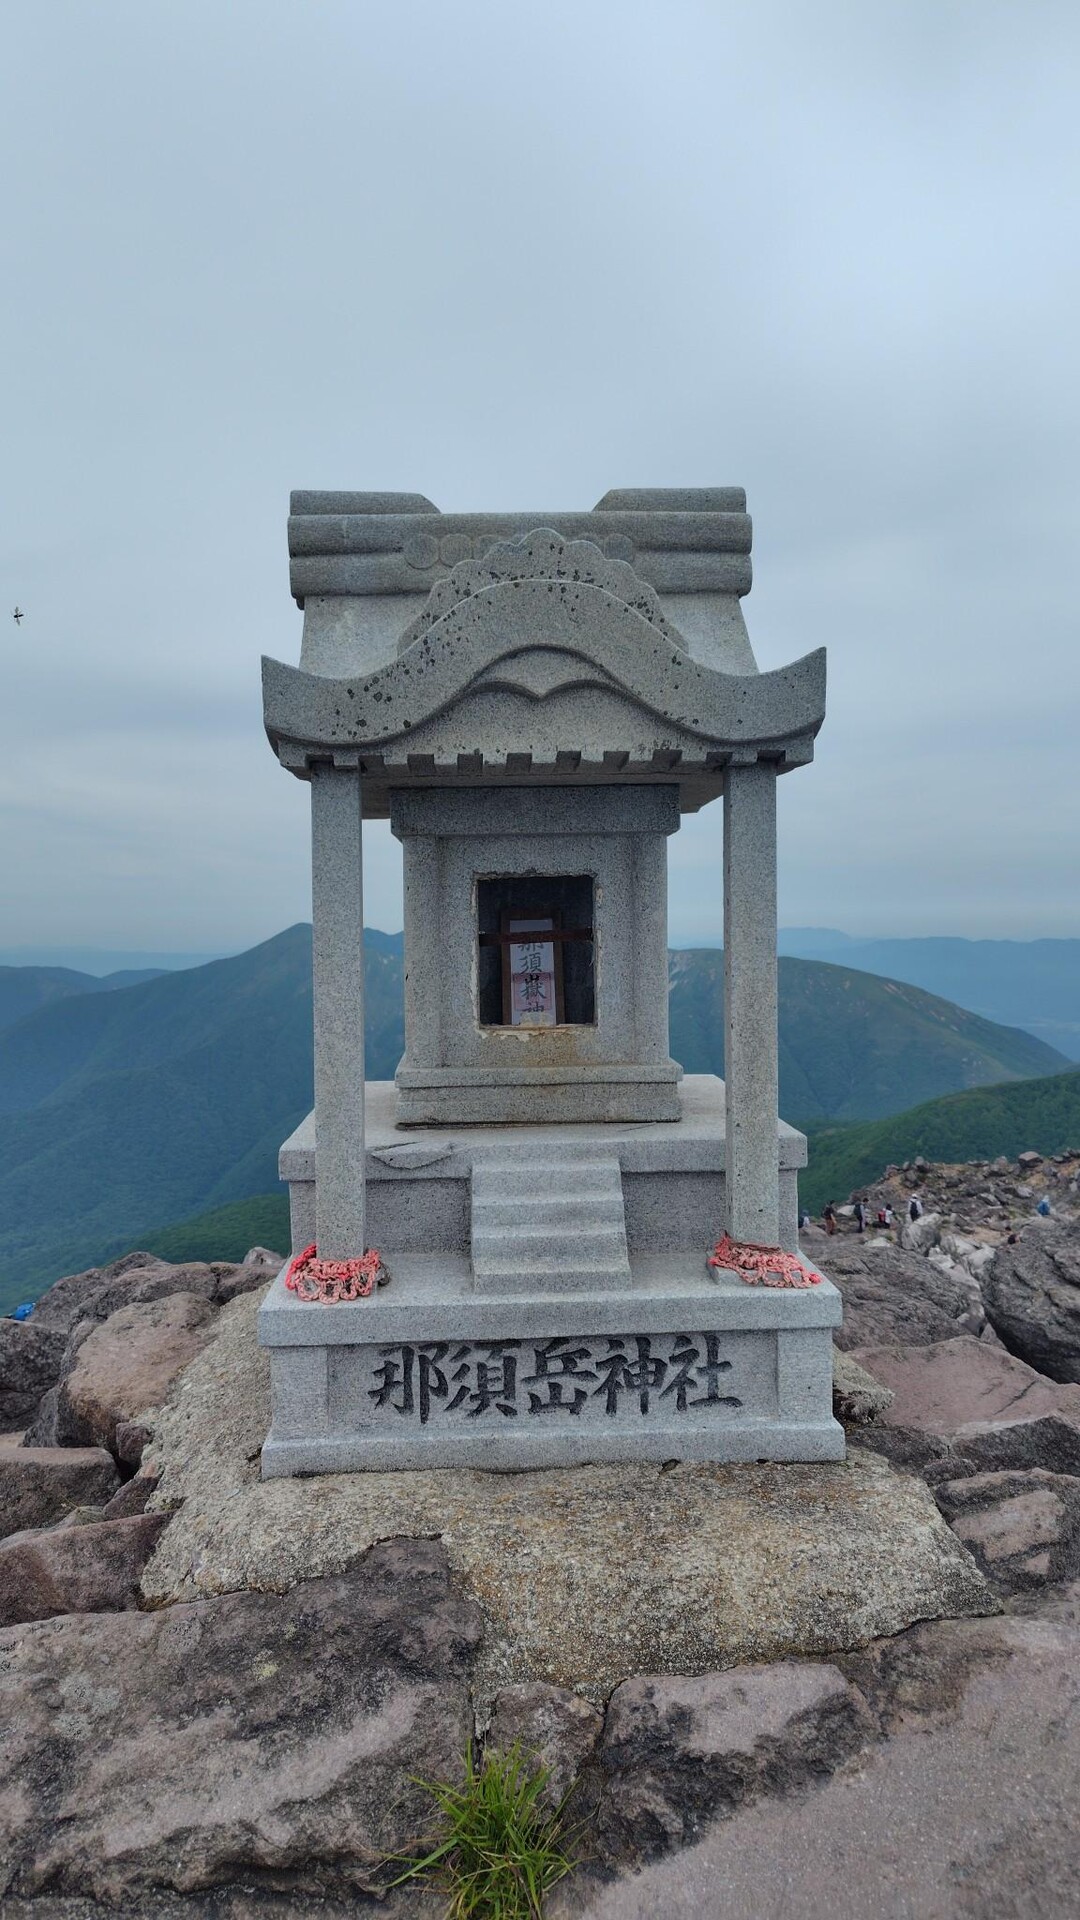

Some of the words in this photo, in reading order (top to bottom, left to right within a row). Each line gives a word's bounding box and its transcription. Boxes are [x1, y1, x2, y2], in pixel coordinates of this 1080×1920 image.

[367, 1332, 743, 1424] 那須岳神社
